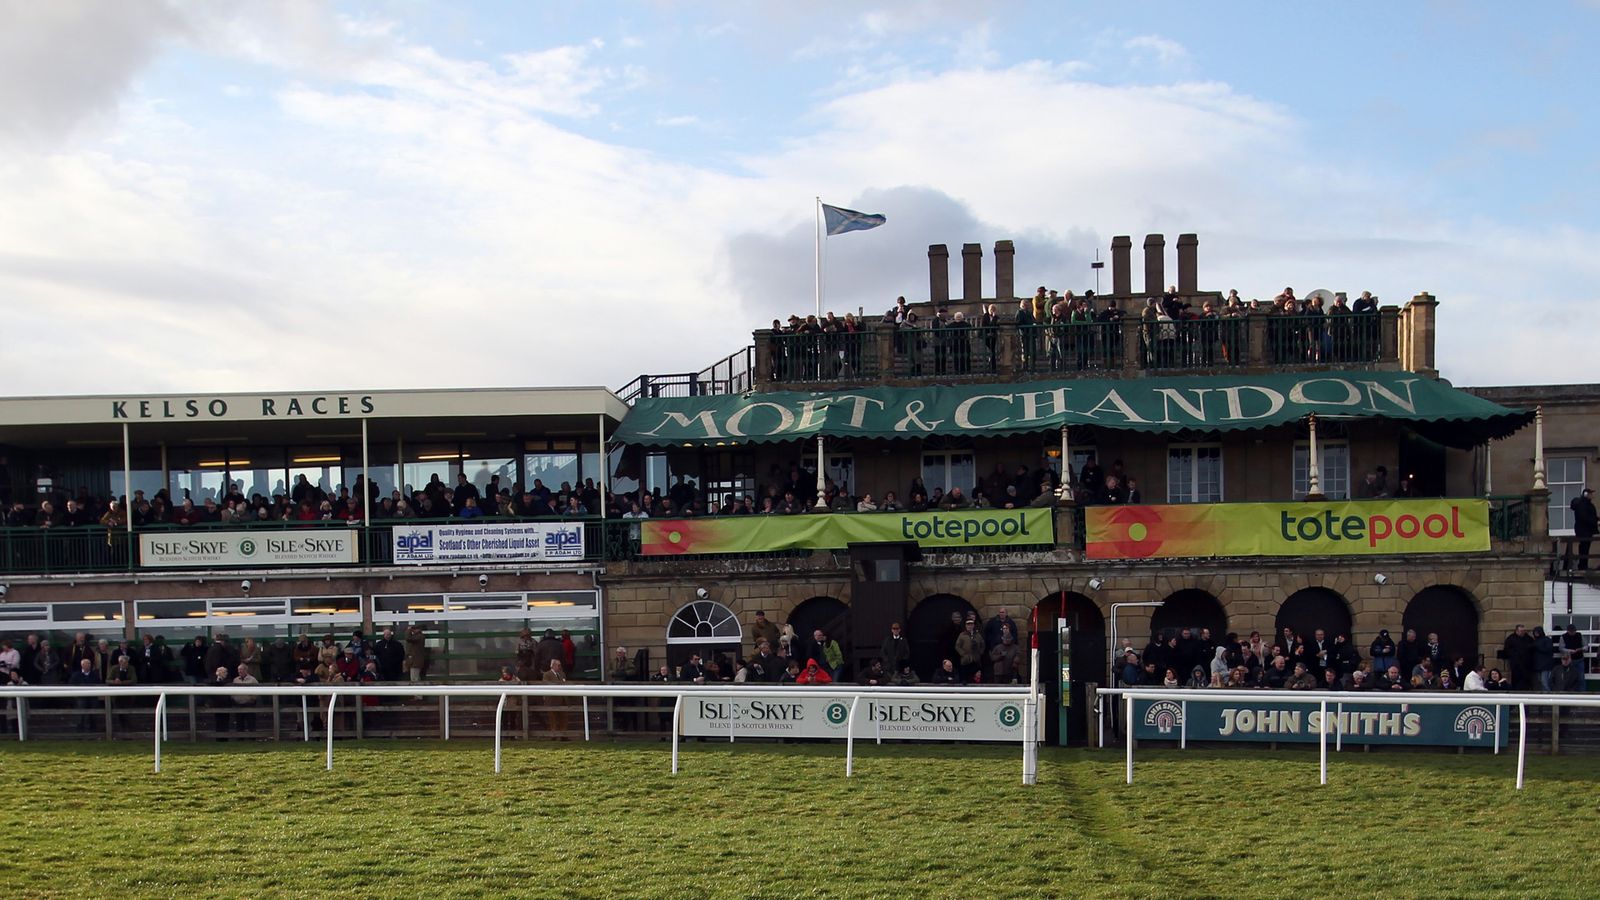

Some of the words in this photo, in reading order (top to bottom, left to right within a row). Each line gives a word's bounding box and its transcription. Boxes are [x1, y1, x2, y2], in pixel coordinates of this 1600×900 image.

[112, 399, 228, 418] KELSO
[261, 396, 375, 416] RACES
[895, 399, 944, 432] &
[954, 378, 1419, 430] CHANDON
[902, 512, 1030, 543] totepool
[1281, 506, 1465, 548] totepool
[151, 541, 182, 555] ISLE
[189, 540, 229, 554] SKYE
[266, 538, 298, 553] ISLE
[304, 538, 345, 552] SKYE
[439, 539, 466, 550] Scotland's
[467, 539, 481, 550] Other
[481, 538, 508, 550] Cherished
[508, 538, 525, 550] Liquid
[525, 538, 540, 548] Asset
[699, 700, 740, 720] ISLE
[750, 700, 804, 720] SKYE
[868, 702, 911, 721] ISLE
[920, 702, 976, 723] SKYE
[1147, 704, 1162, 724] JOHN
[1219, 708, 1299, 735] JOHN
[1308, 703, 1421, 736] SMITH'S
[1457, 709, 1472, 730] JOHN
[768, 722, 793, 730] WHISKY
